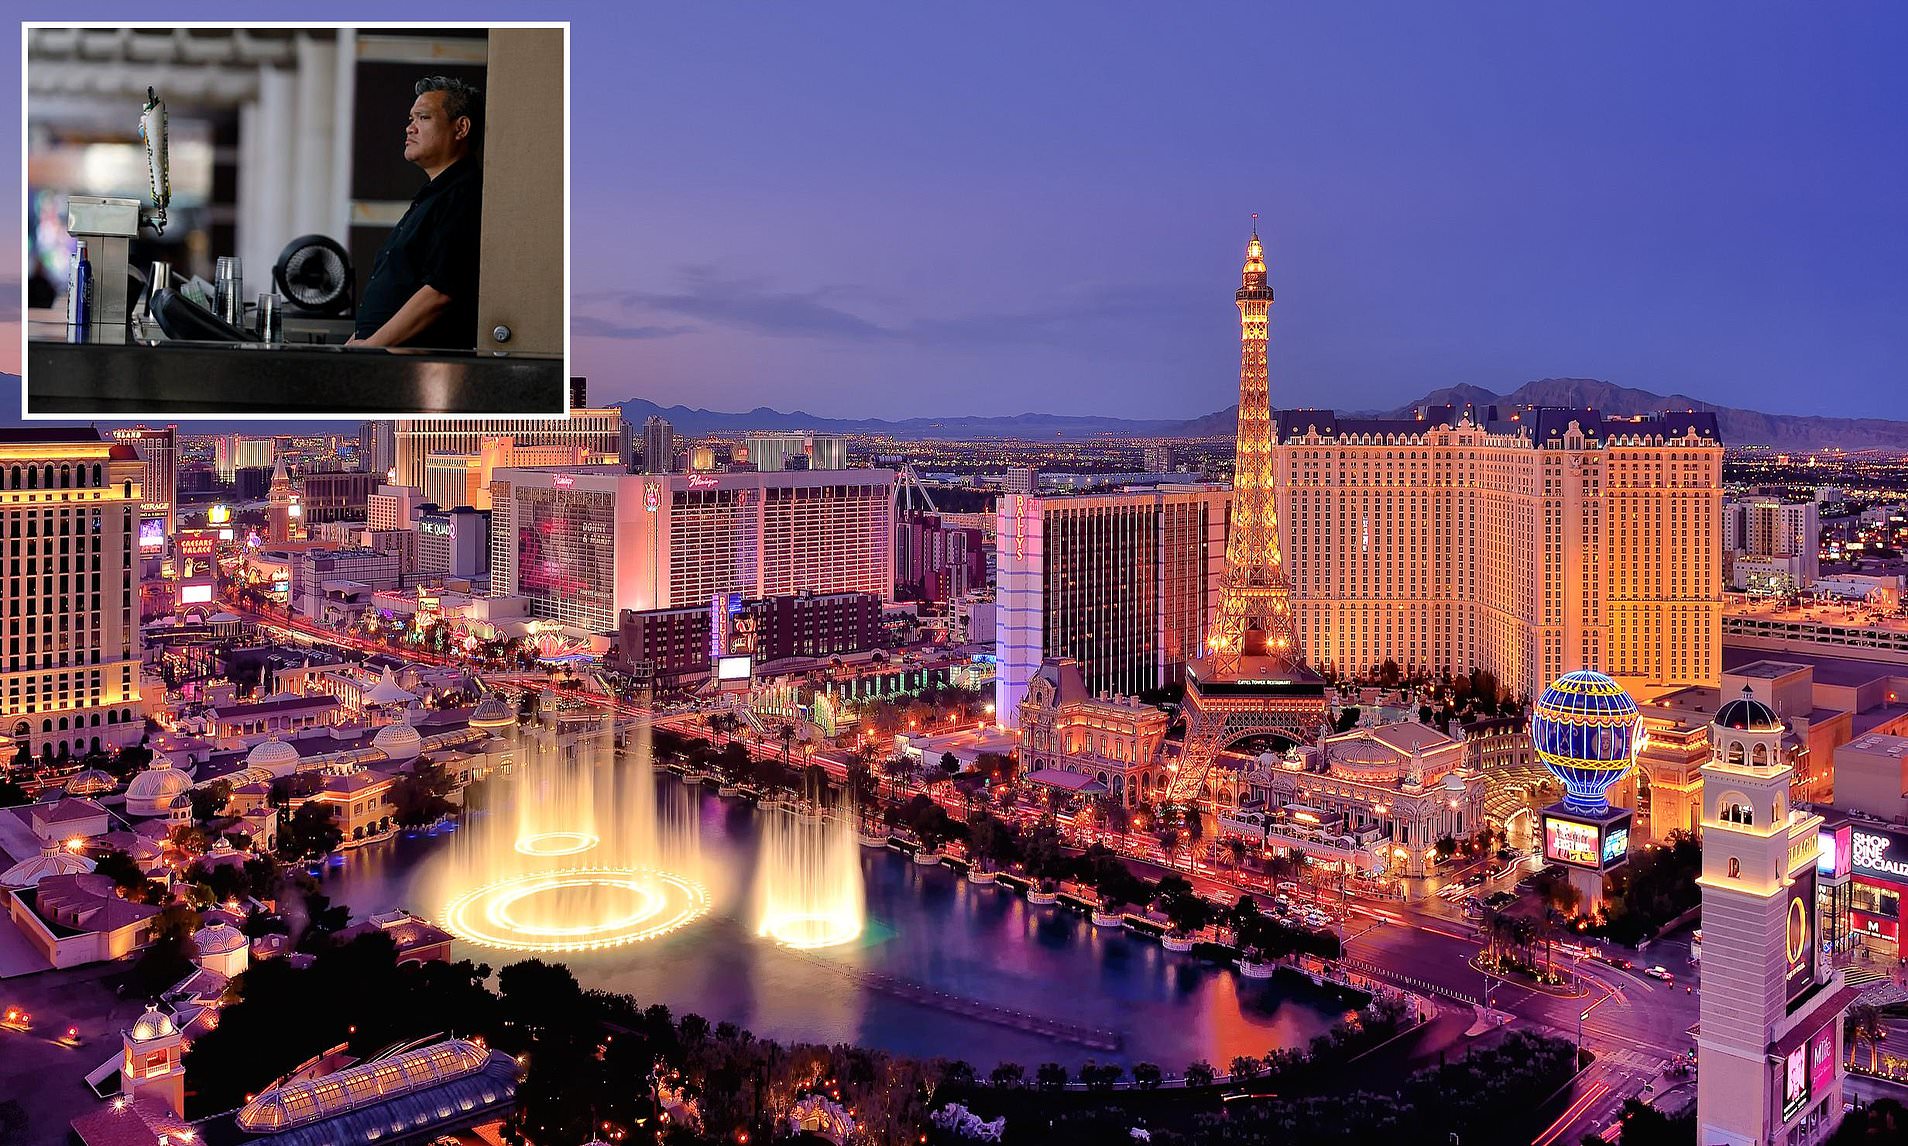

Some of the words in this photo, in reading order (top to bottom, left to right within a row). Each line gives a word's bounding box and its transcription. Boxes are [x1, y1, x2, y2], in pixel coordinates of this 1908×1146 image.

[421, 522, 433, 534] THE
[434, 524, 451, 536] QUAD
[182, 546, 211, 554] PALACE
[1853, 832, 1890, 850] SHOP
[1853, 842, 1883, 860] DINE
[1867, 920, 1879, 933] M
